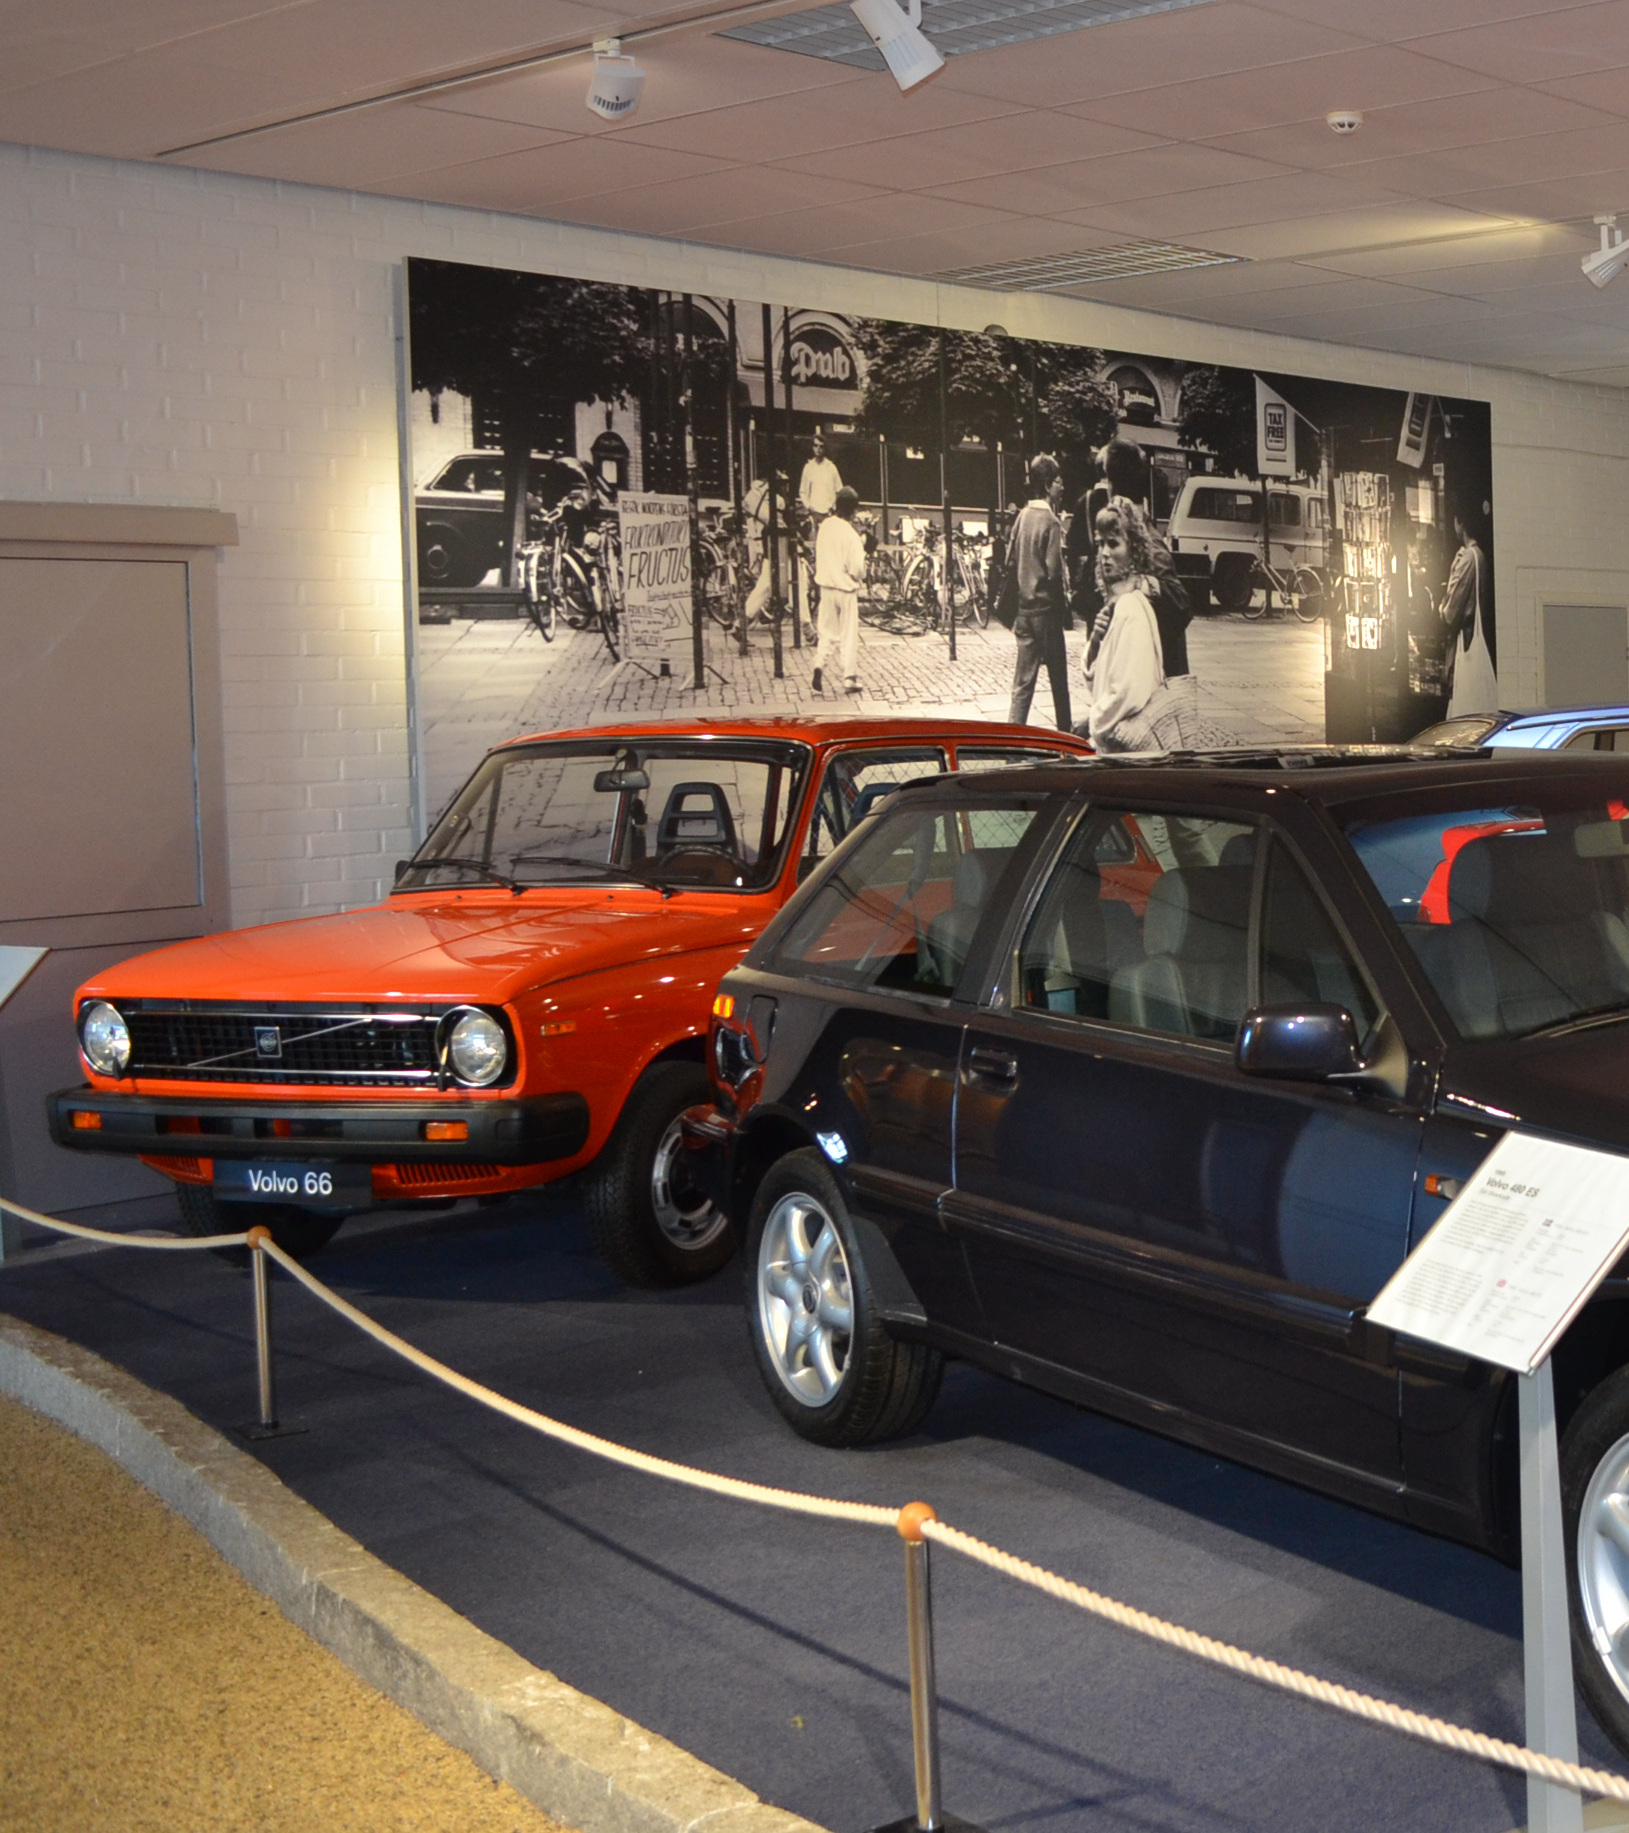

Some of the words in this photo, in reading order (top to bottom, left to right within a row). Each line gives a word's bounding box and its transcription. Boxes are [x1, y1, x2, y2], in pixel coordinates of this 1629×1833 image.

[790, 341, 850, 383] Pub
[1268, 412, 1283, 426] TAX
[1267, 425, 1285, 439] FREE
[628, 546, 690, 590] FRUCTUS
[248, 1169, 299, 1194] Volvo
[304, 1171, 333, 1195] 66
[1486, 1177, 1509, 1190] Volvo
